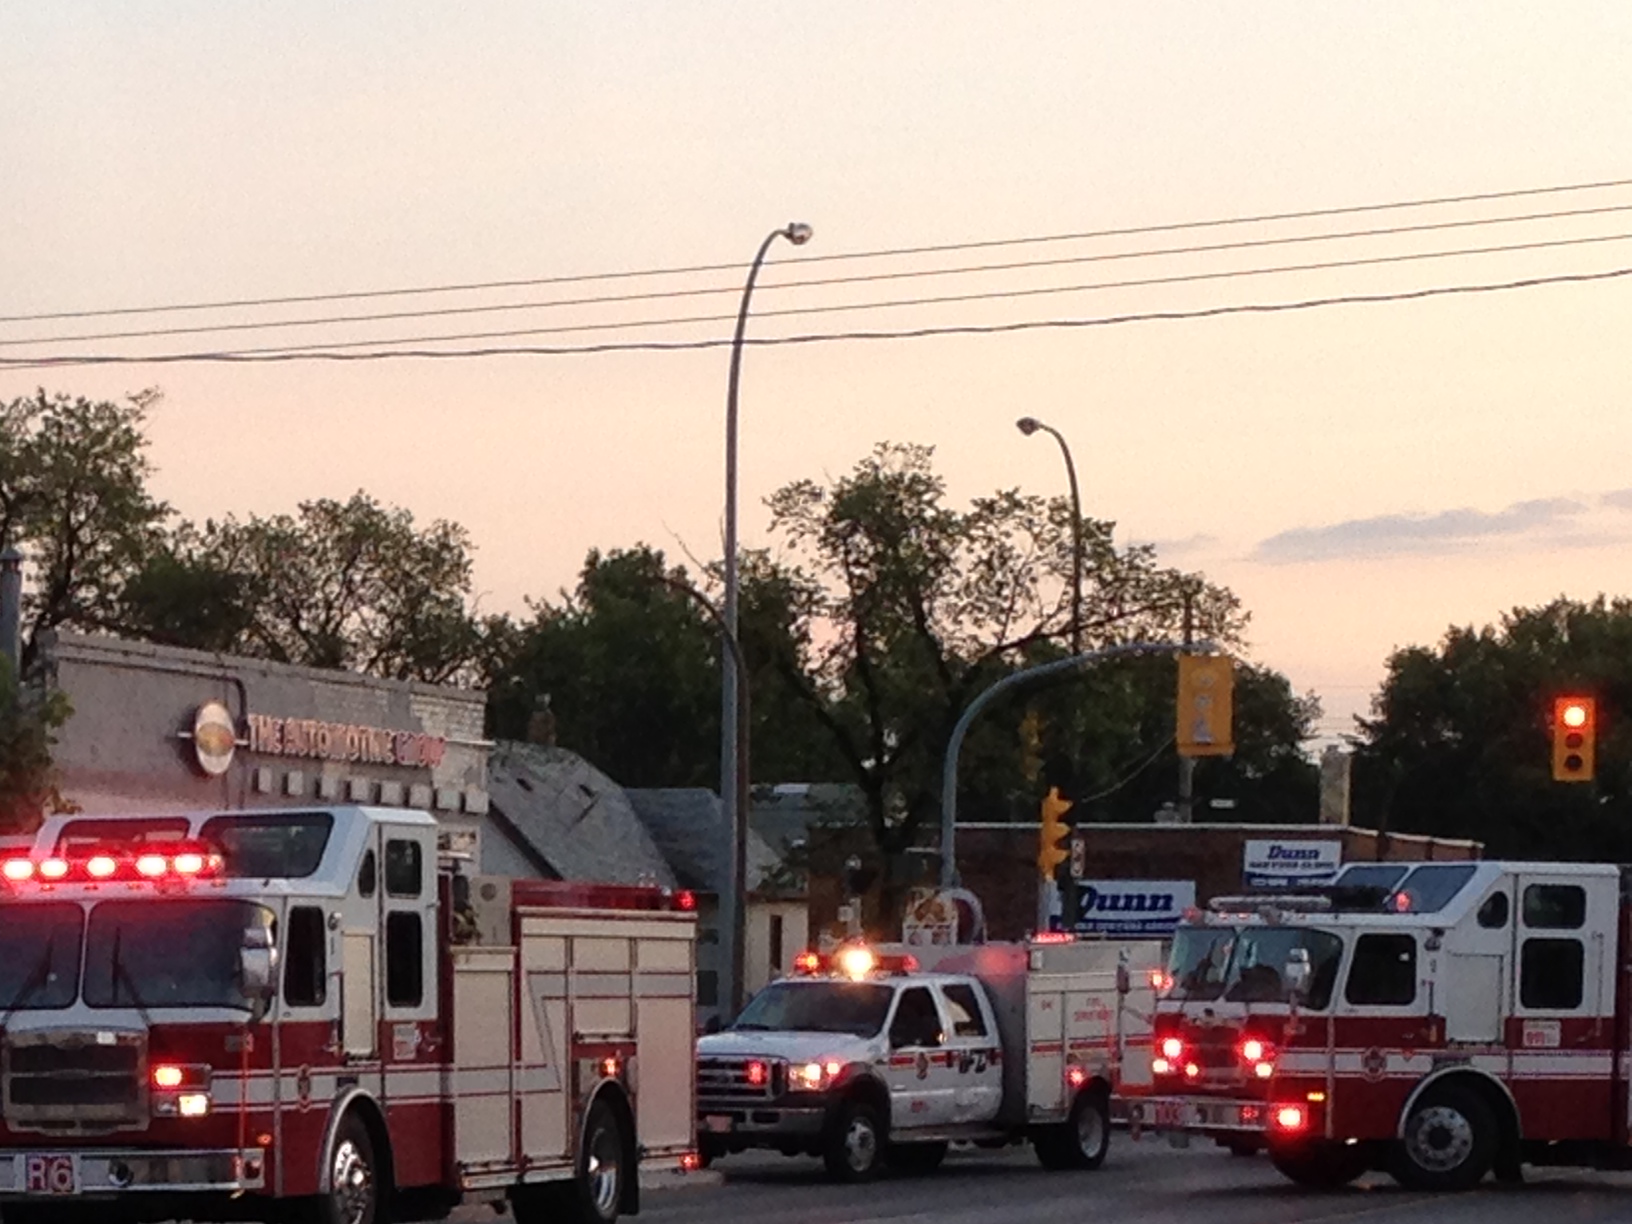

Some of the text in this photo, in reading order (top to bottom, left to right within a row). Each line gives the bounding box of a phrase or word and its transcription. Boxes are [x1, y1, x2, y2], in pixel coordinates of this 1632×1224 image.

[248, 713, 284, 754] THE
[1267, 845, 1321, 860] Dunn
[27, 1157, 73, 1191] R6
